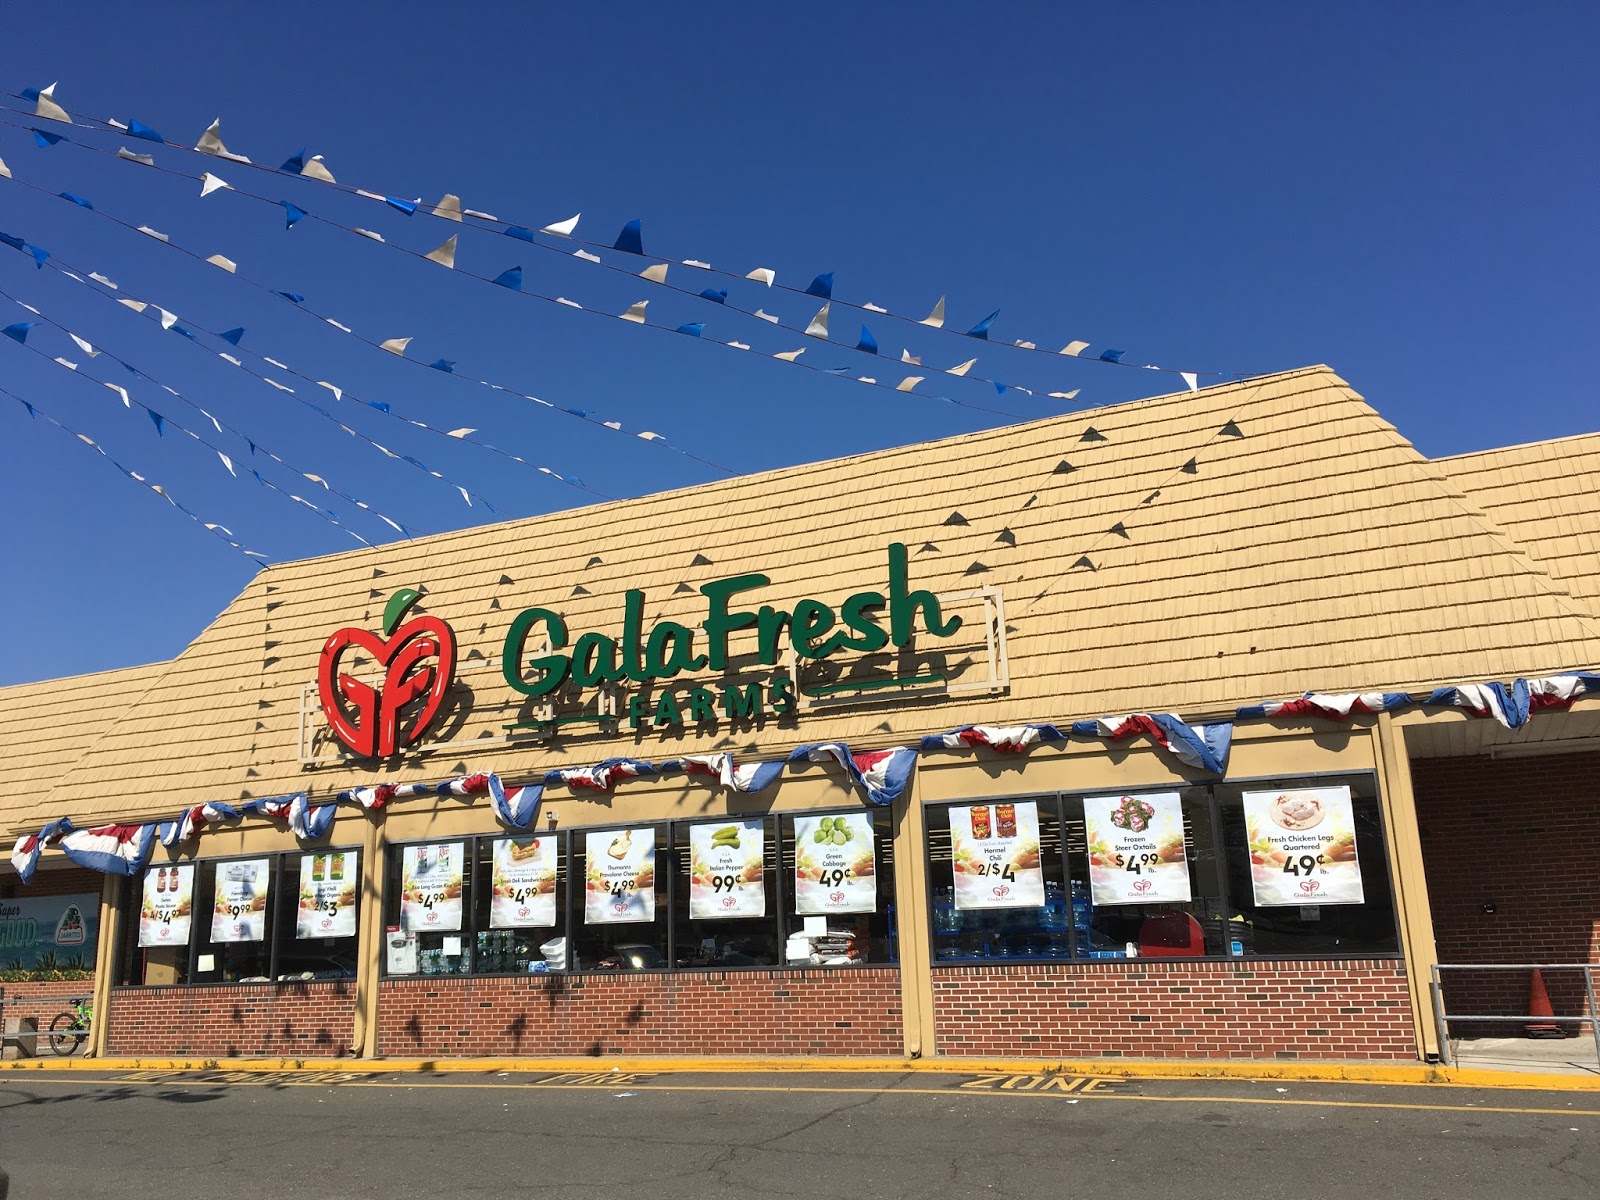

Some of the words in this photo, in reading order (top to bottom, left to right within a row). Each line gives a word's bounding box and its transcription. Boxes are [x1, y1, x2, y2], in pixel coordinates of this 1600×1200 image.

[630, 678, 797, 728] FARMS
[1288, 835, 1317, 843] Chicken
[1318, 834, 1334, 842] Legs
[1283, 843, 1320, 851] Quartered
[725, 864, 744, 872] Pepper
[977, 862, 1016, 883] 2/$4
[314, 900, 338, 917] 2/$3
[60, 931, 81, 939] JARRITOS
[536, 1073, 659, 1084] FIRE
[960, 1074, 1127, 1093] ZONE
